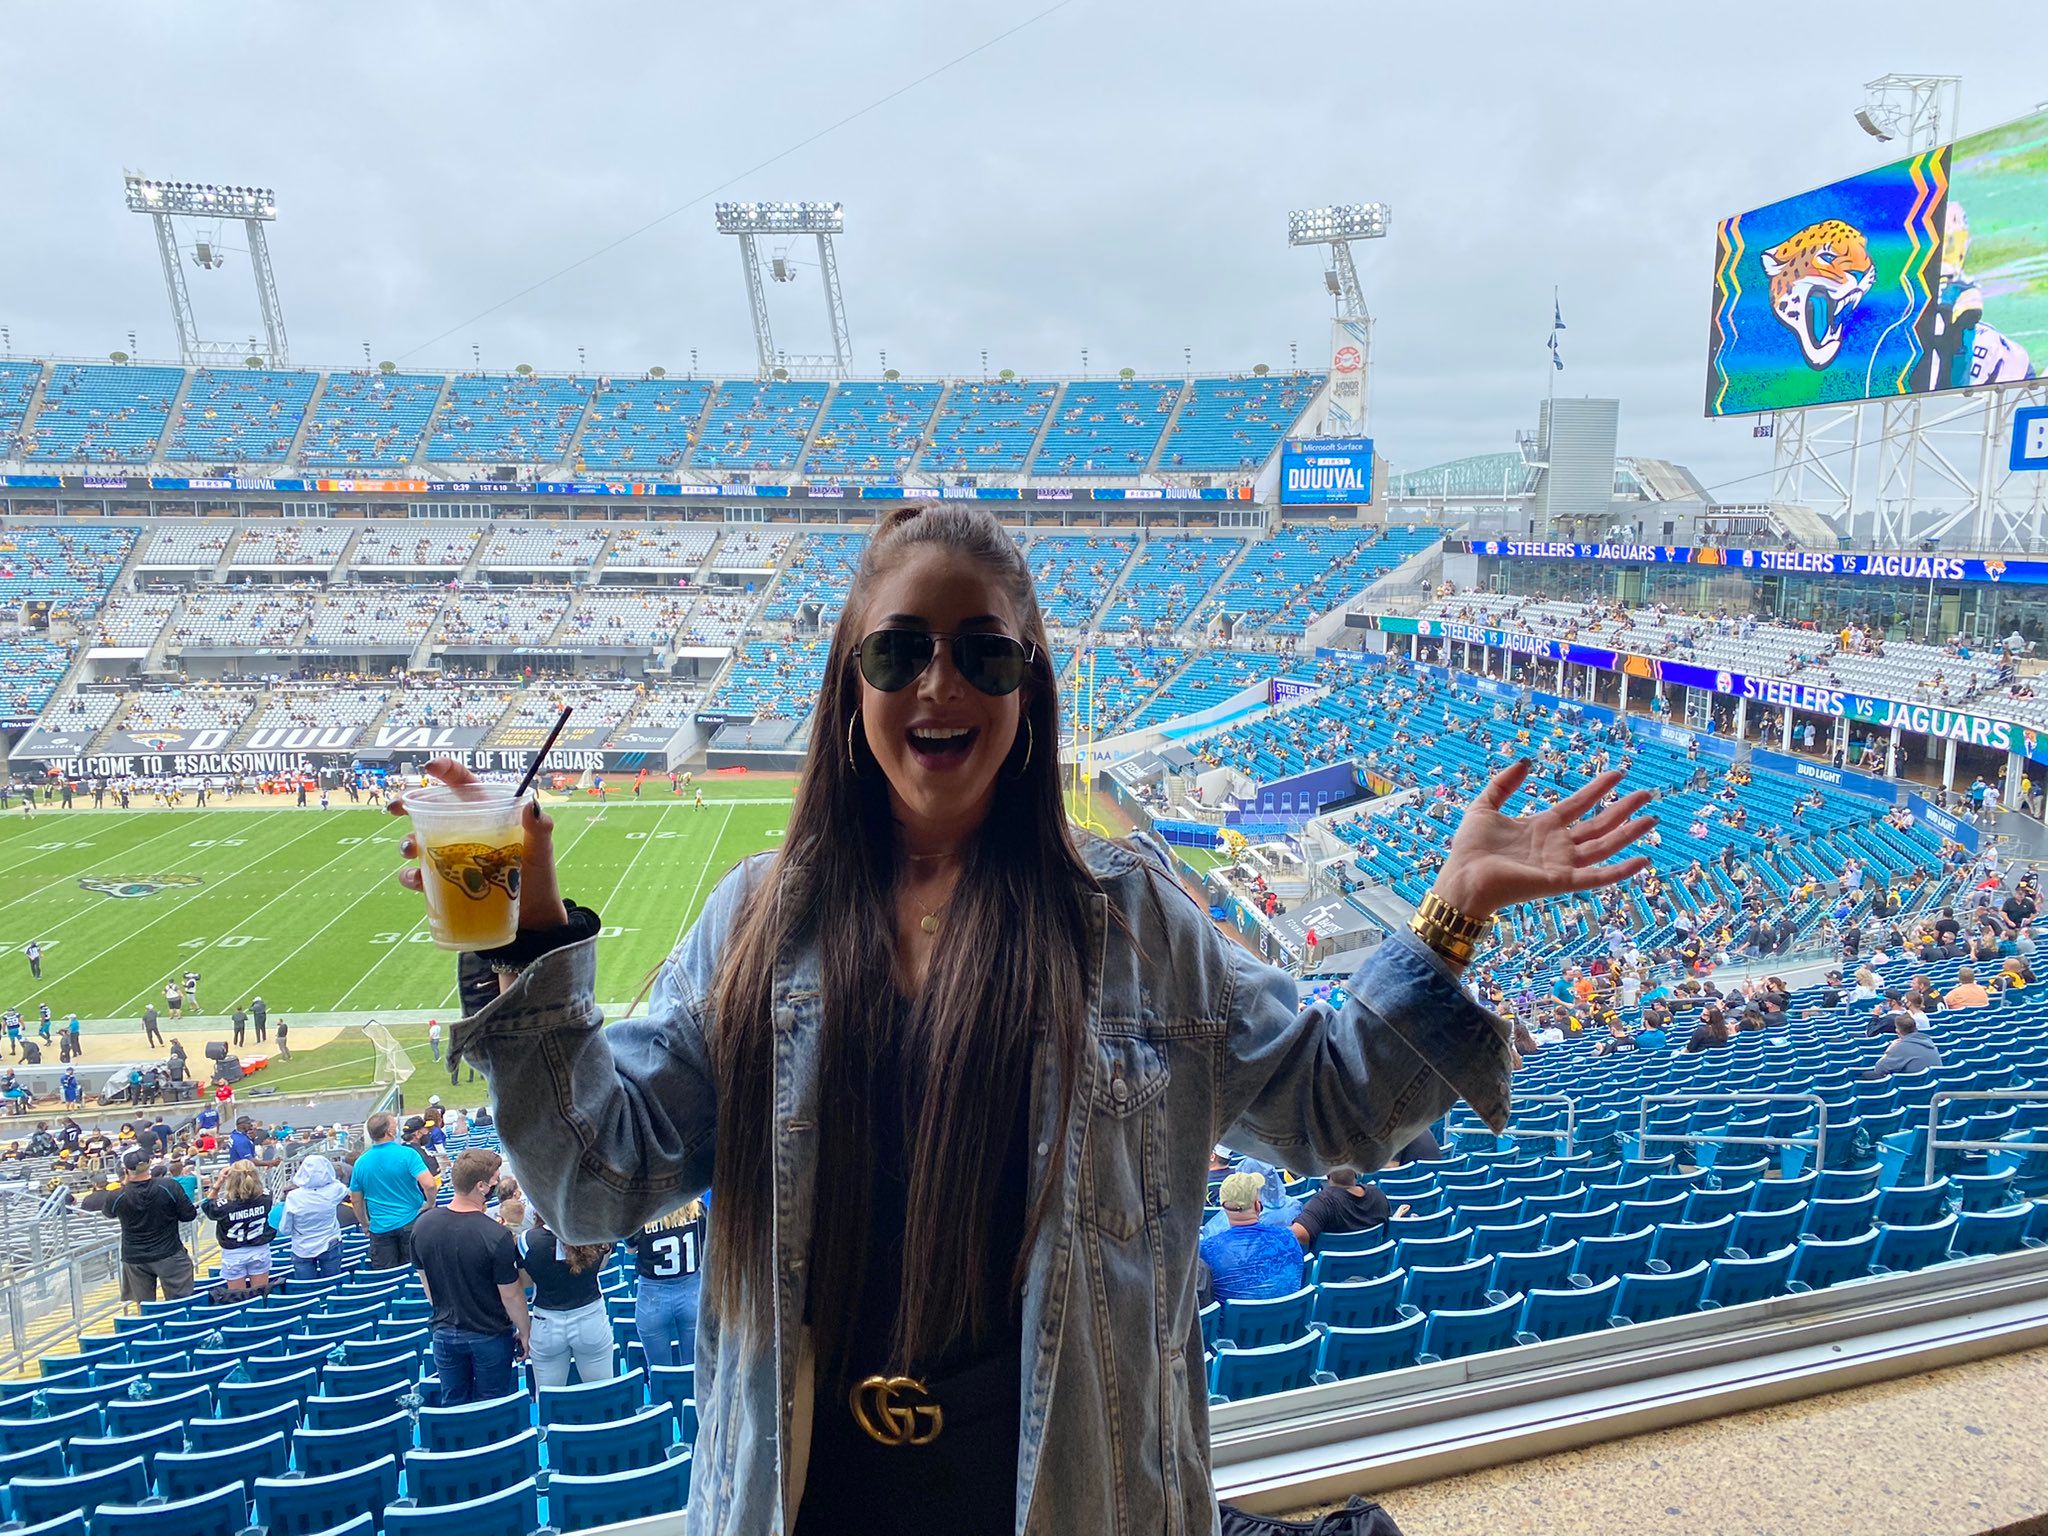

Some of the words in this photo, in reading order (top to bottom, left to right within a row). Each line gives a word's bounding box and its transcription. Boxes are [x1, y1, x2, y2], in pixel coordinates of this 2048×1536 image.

[1303, 443, 1336, 451] Microsoft
[1337, 443, 1363, 451] Surface
[235, 479, 276, 490] DUUUVAL
[1288, 467, 1365, 489] DUUUVAL
[721, 485, 757, 496] DUUUVAL
[943, 488, 977, 498] DUUUVAL
[1130, 490, 1157, 498] FIRST
[1166, 488, 1201, 499] DUUUVAL
[1506, 541, 1575, 558] STEELERS
[1594, 544, 1656, 561] JAGUARS
[1760, 550, 1835, 573] STEELERS
[1860, 556, 1965, 580] JAGUARS
[1440, 621, 1486, 644] STEELERS
[1499, 633, 1551, 657] JAGUARS
[1743, 676, 1846, 716] STEELERS
[1880, 702, 2012, 750] JAGUARS
[50, 756, 135, 777] WELCOME
[140, 755, 163, 775] TO
[173, 752, 307, 775] #SACKSONVILLE
[475, 751, 494, 769] OF
[499, 751, 527, 769] THE
[1797, 763, 1818, 776] BUD
[1818, 767, 1841, 784] LIGHT
[228, 1205, 265, 1221] WINGARD
[226, 1217, 267, 1242] 42
[652, 1231, 696, 1276] 31
